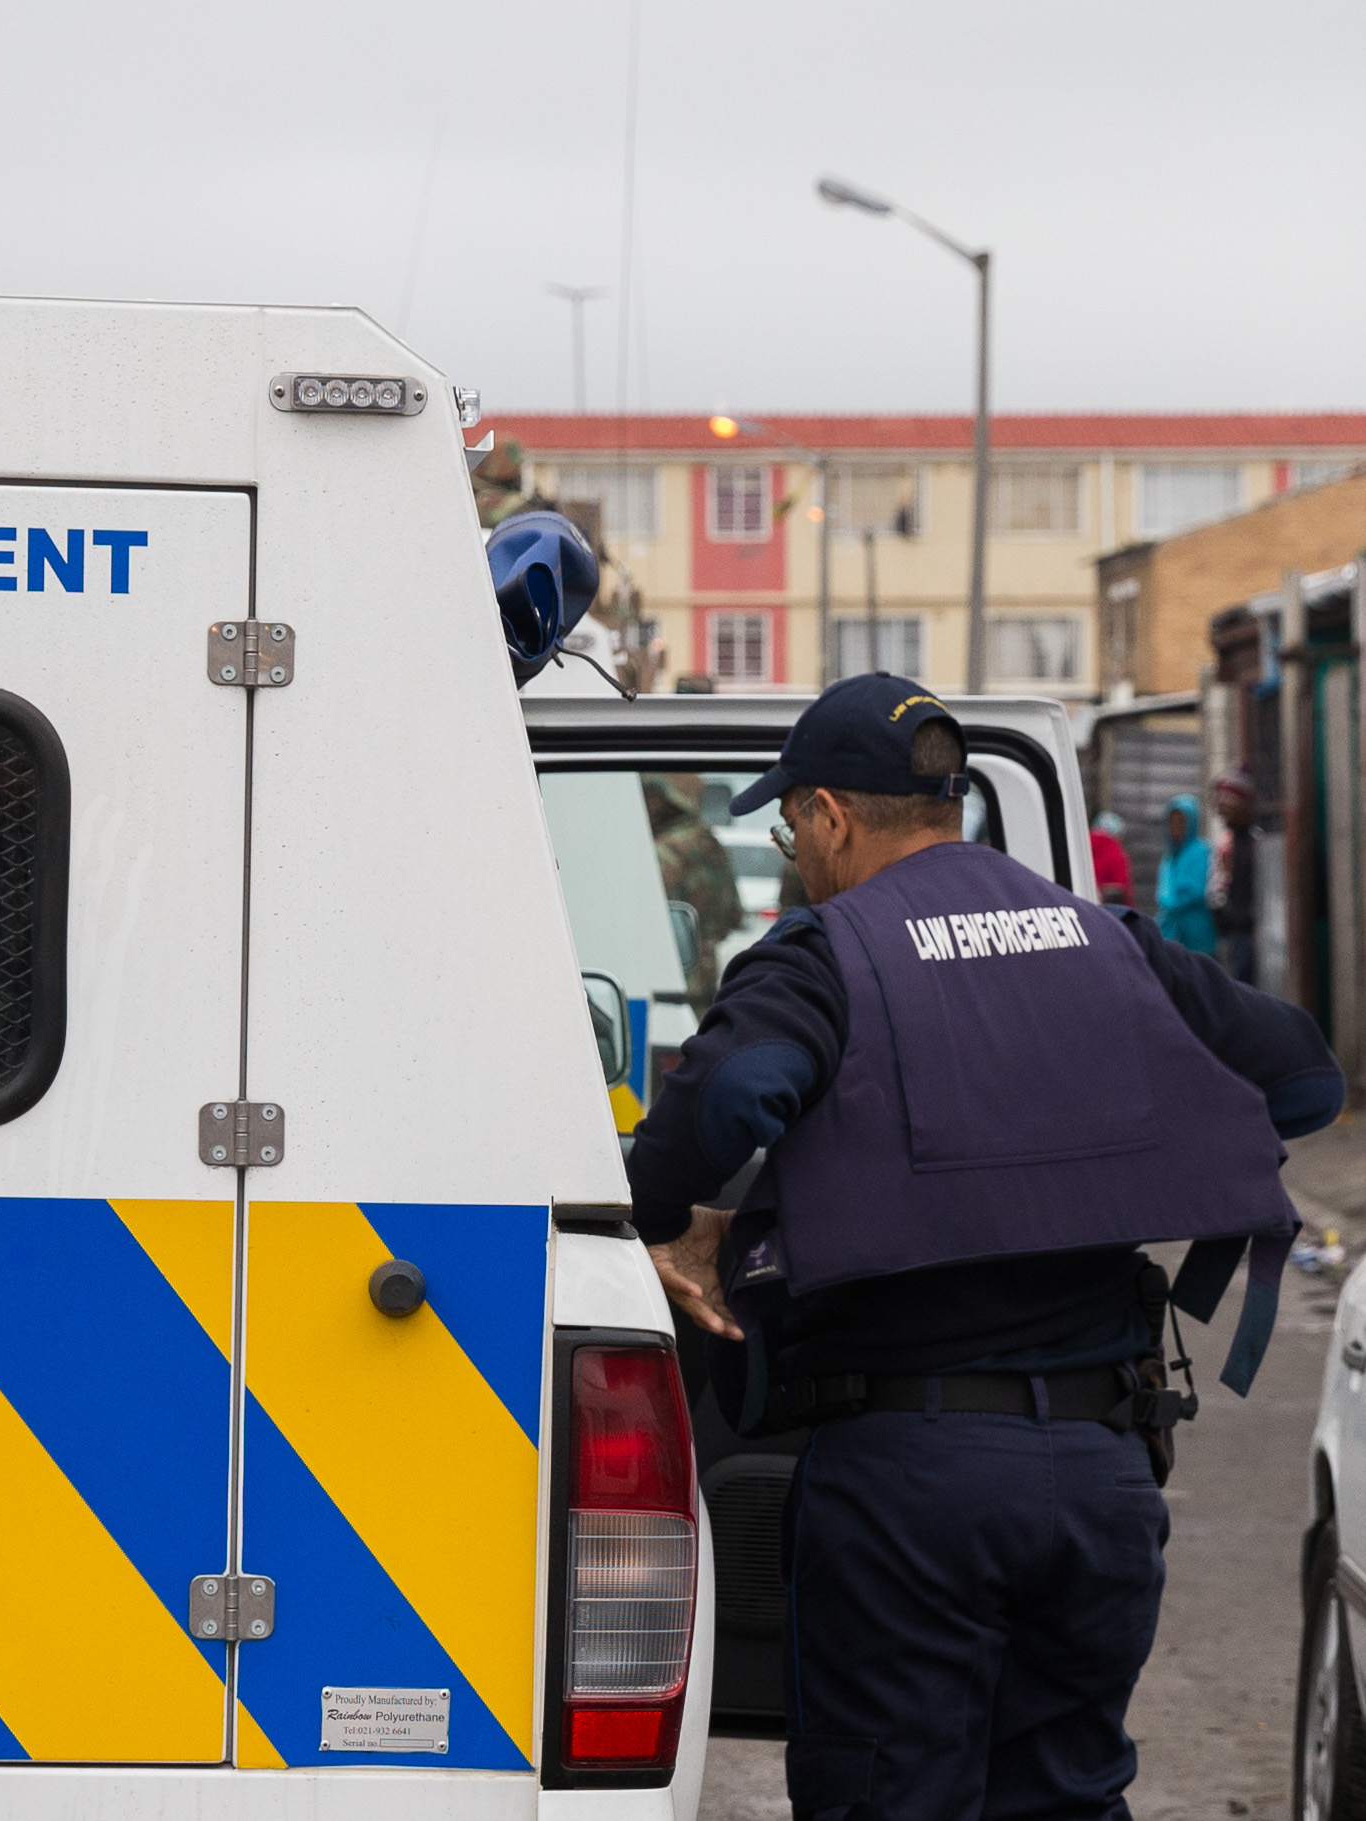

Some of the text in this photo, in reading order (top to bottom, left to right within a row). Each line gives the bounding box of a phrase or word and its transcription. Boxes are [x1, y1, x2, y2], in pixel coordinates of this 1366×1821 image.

[905, 906, 1090, 961] LAW ENFORCEMENT
[335, 1694, 437, 1708] Proudly Manufactured by:
[326, 1709, 445, 1724] Rainbow Polyurethane
[392, 1727, 411, 1736] 6641
[342, 1739, 366, 1747] Serial
